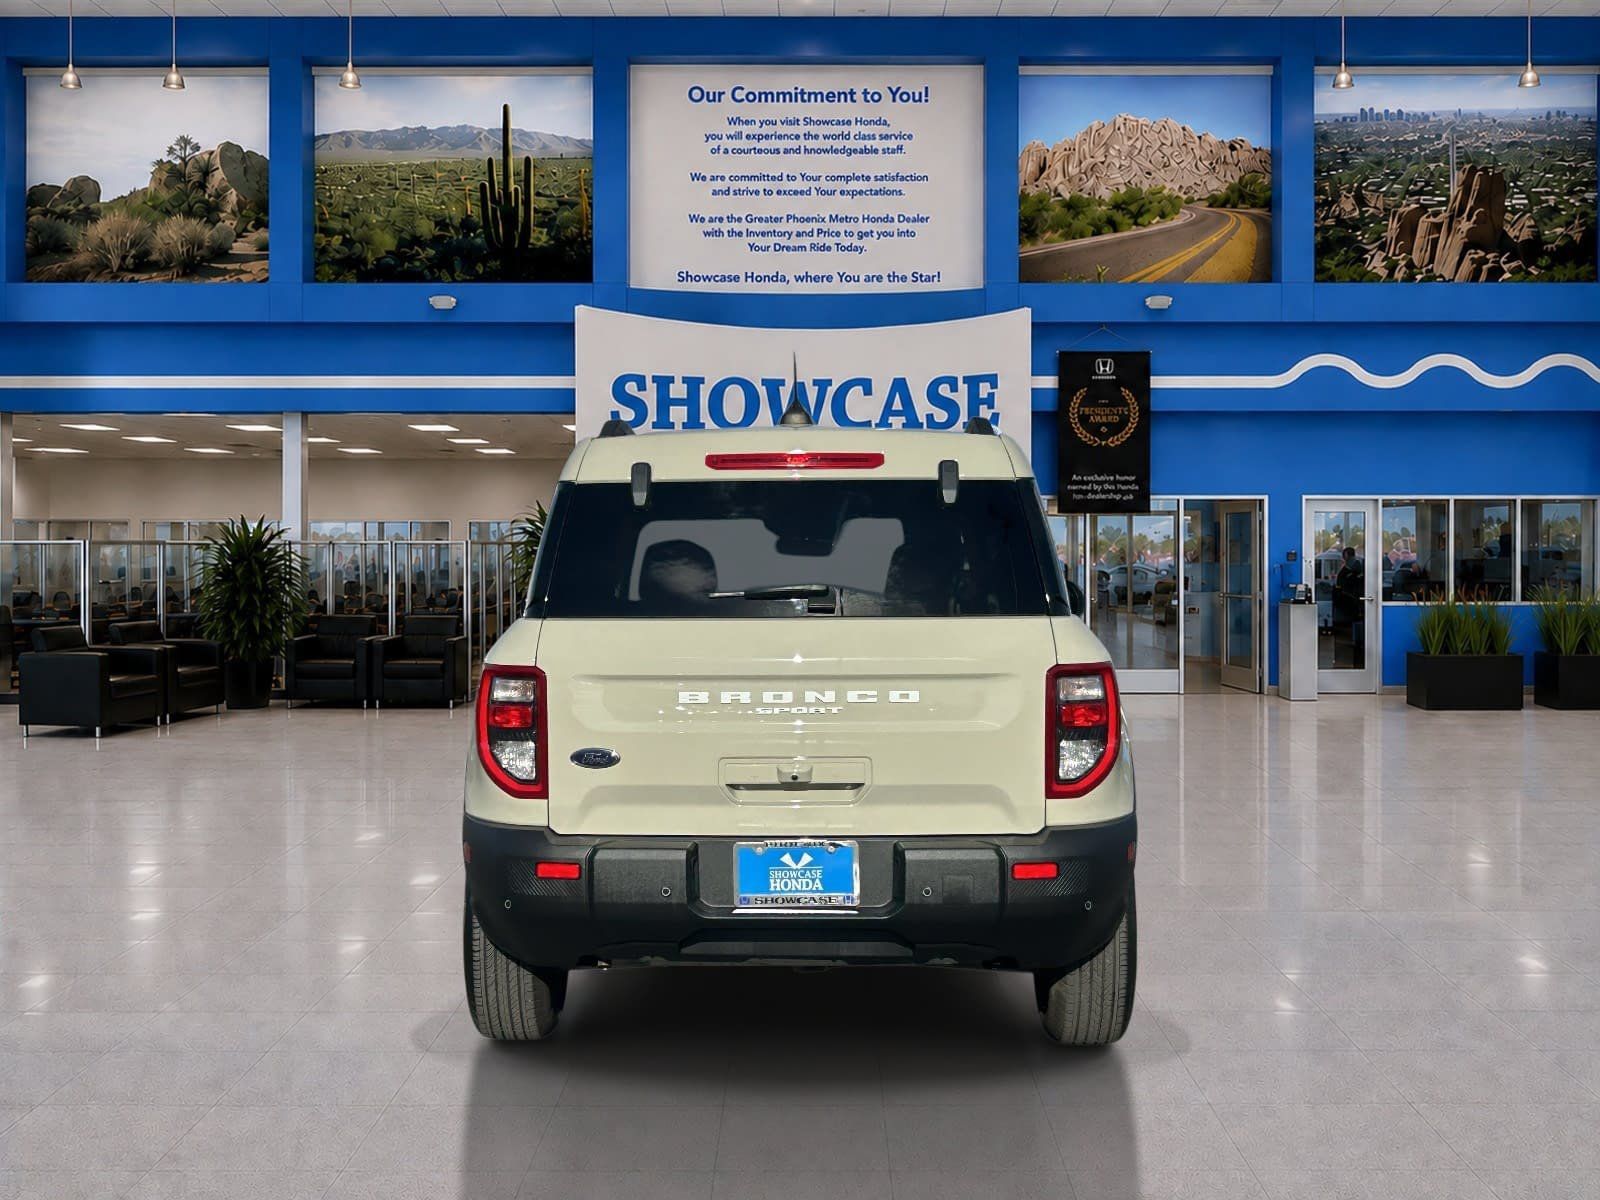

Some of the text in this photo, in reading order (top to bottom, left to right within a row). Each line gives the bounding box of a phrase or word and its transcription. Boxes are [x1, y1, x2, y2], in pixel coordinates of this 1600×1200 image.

[687, 85, 929, 104] Our Commitment to You!
[726, 115, 891, 129] When you visit Showcase Honda,
[704, 130, 914, 144] you will experience the world class service
[709, 144, 721, 155] of
[722, 147, 730, 155] a
[730, 146, 781, 156] courteous
[782, 144, 802, 155] and
[881, 144, 906, 155] staff.
[689, 171, 929, 185] We are committed to Your complete satisfaction
[711, 186, 906, 200] and strive to exceed Your expectations.
[688, 213, 931, 224] We are the Greater Phoenix Metro Honda Dealer
[702, 227, 917, 241] with the Inventory and Price to get you into
[747, 242, 868, 255] Your Dream Ride Today.
[677, 270, 941, 286] Showcase Honda, where You are the Star!
[609, 372, 1001, 430] SHOWCASE
[678, 690, 921, 704] BRONCO
[754, 706, 844, 715] SPORT
[769, 869, 823, 879] SHOWCASE
[769, 878, 825, 891] HONDA
[754, 896, 839, 905] SHOWCASE
